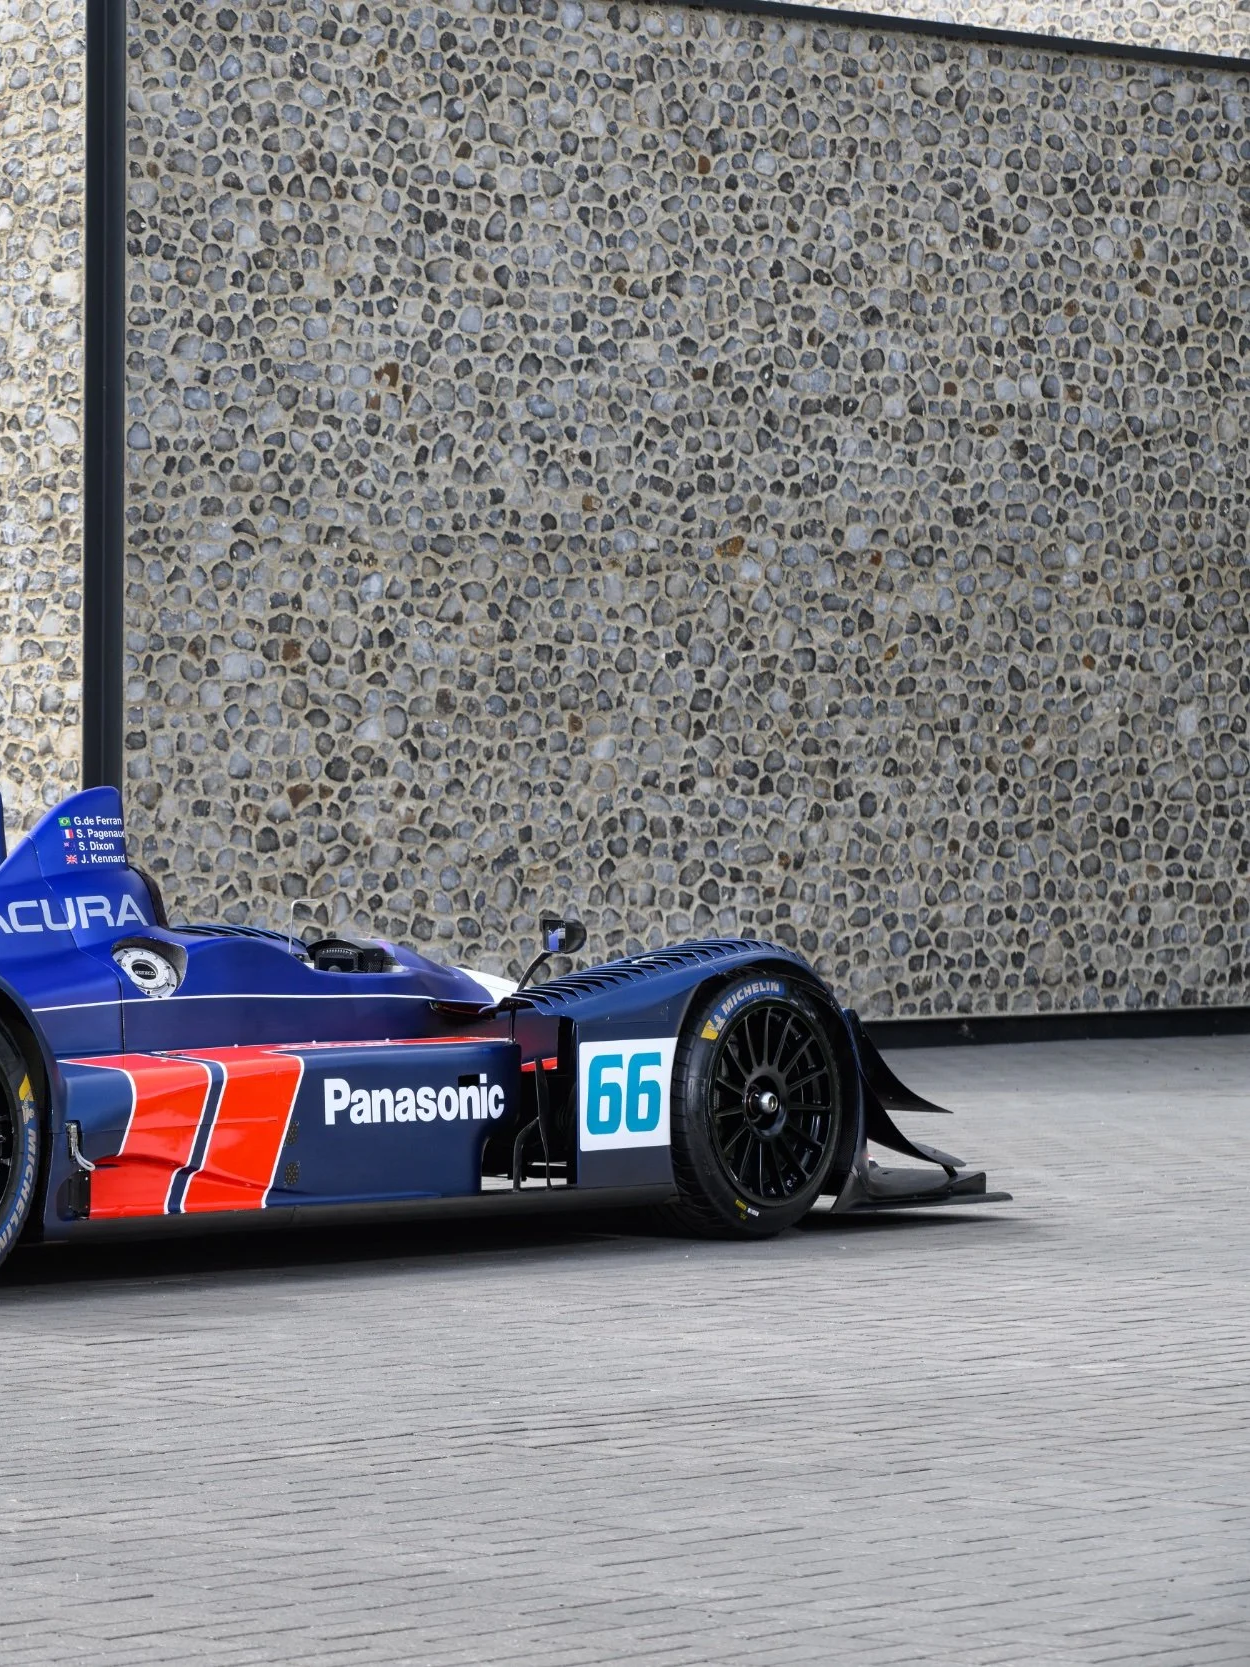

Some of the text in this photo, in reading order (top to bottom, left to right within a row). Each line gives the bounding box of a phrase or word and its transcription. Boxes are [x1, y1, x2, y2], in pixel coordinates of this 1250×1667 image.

[76, 829, 86, 838] S.
[78, 841, 115, 851] S. Dixon
[81, 854, 126, 864] J. Kennard
[721, 981, 780, 1015] MICHELIN
[323, 1073, 505, 1125] Panasonic
[586, 1052, 662, 1136] 66
